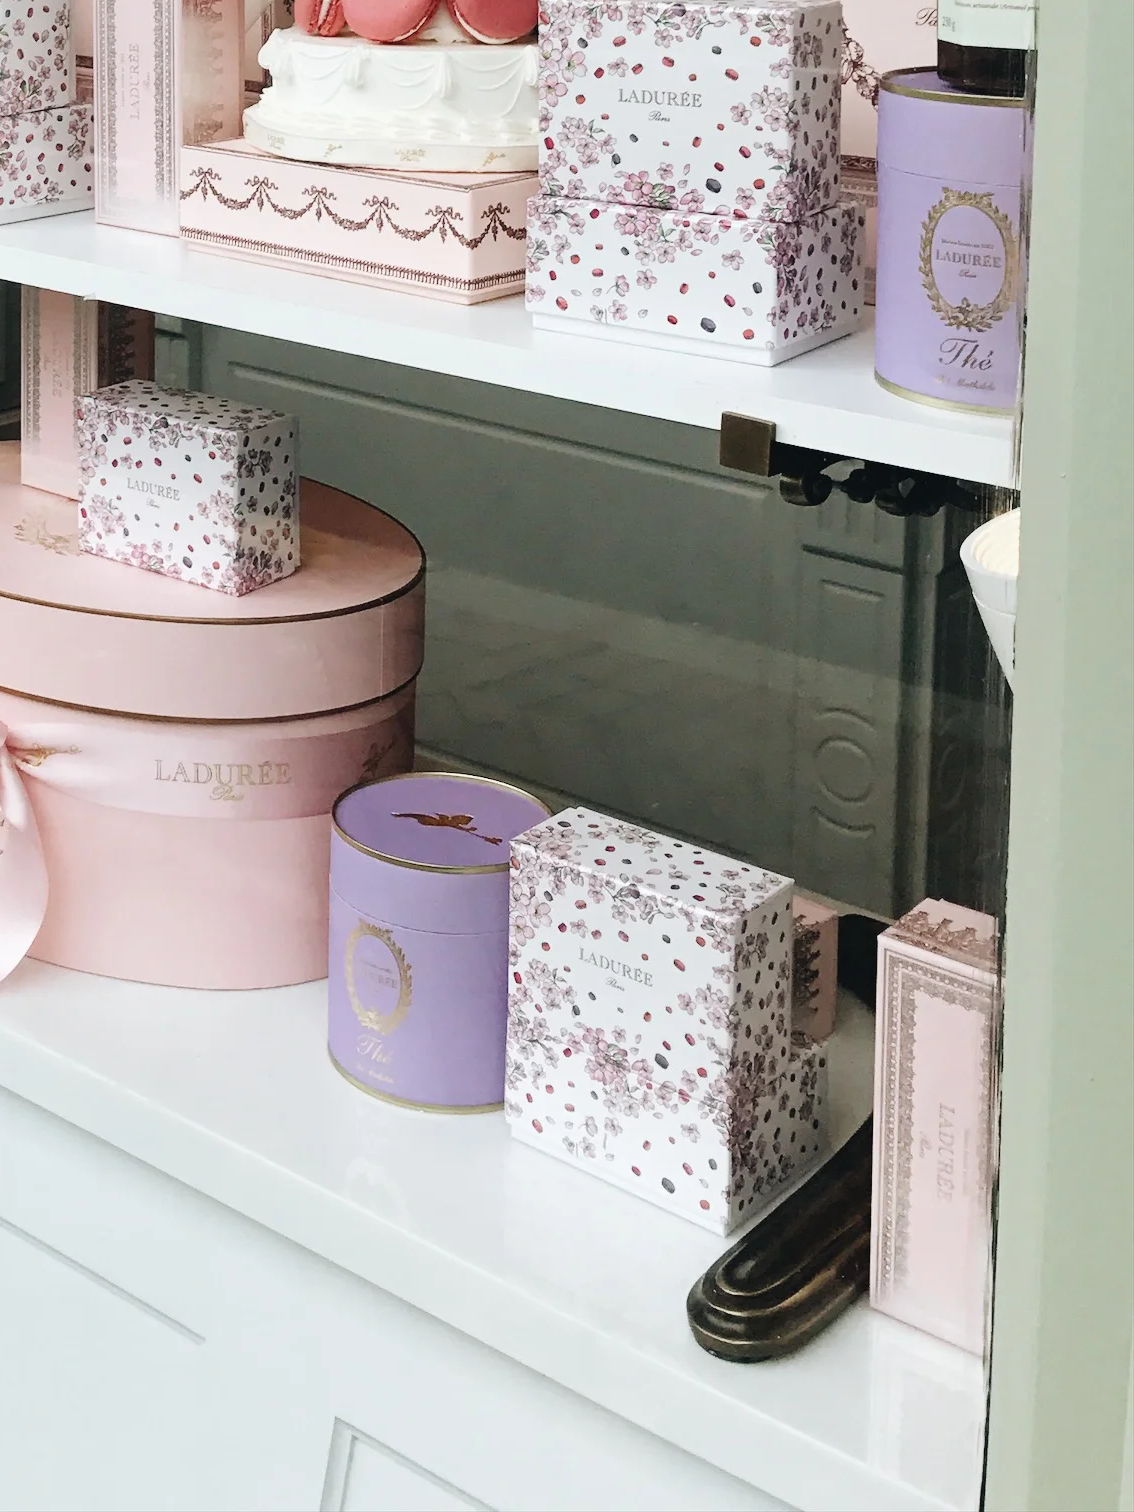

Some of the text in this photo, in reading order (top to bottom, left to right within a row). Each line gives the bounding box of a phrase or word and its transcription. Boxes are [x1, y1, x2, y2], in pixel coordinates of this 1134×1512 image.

[129, 43, 140, 120] LADURÉE
[618, 88, 702, 108] LADURÉE
[648, 110, 671, 122] Paris
[936, 249, 1002, 268] LADURÉE
[939, 338, 994, 371] Thé
[127, 477, 181, 501] LADURÉE
[154, 759, 293, 786] LADURÉE
[210, 783, 245, 801] Paris
[579, 947, 653, 987] LADURÉE
[357, 1033, 394, 1065] Thé
[937, 1102, 955, 1202] LADURÉE
